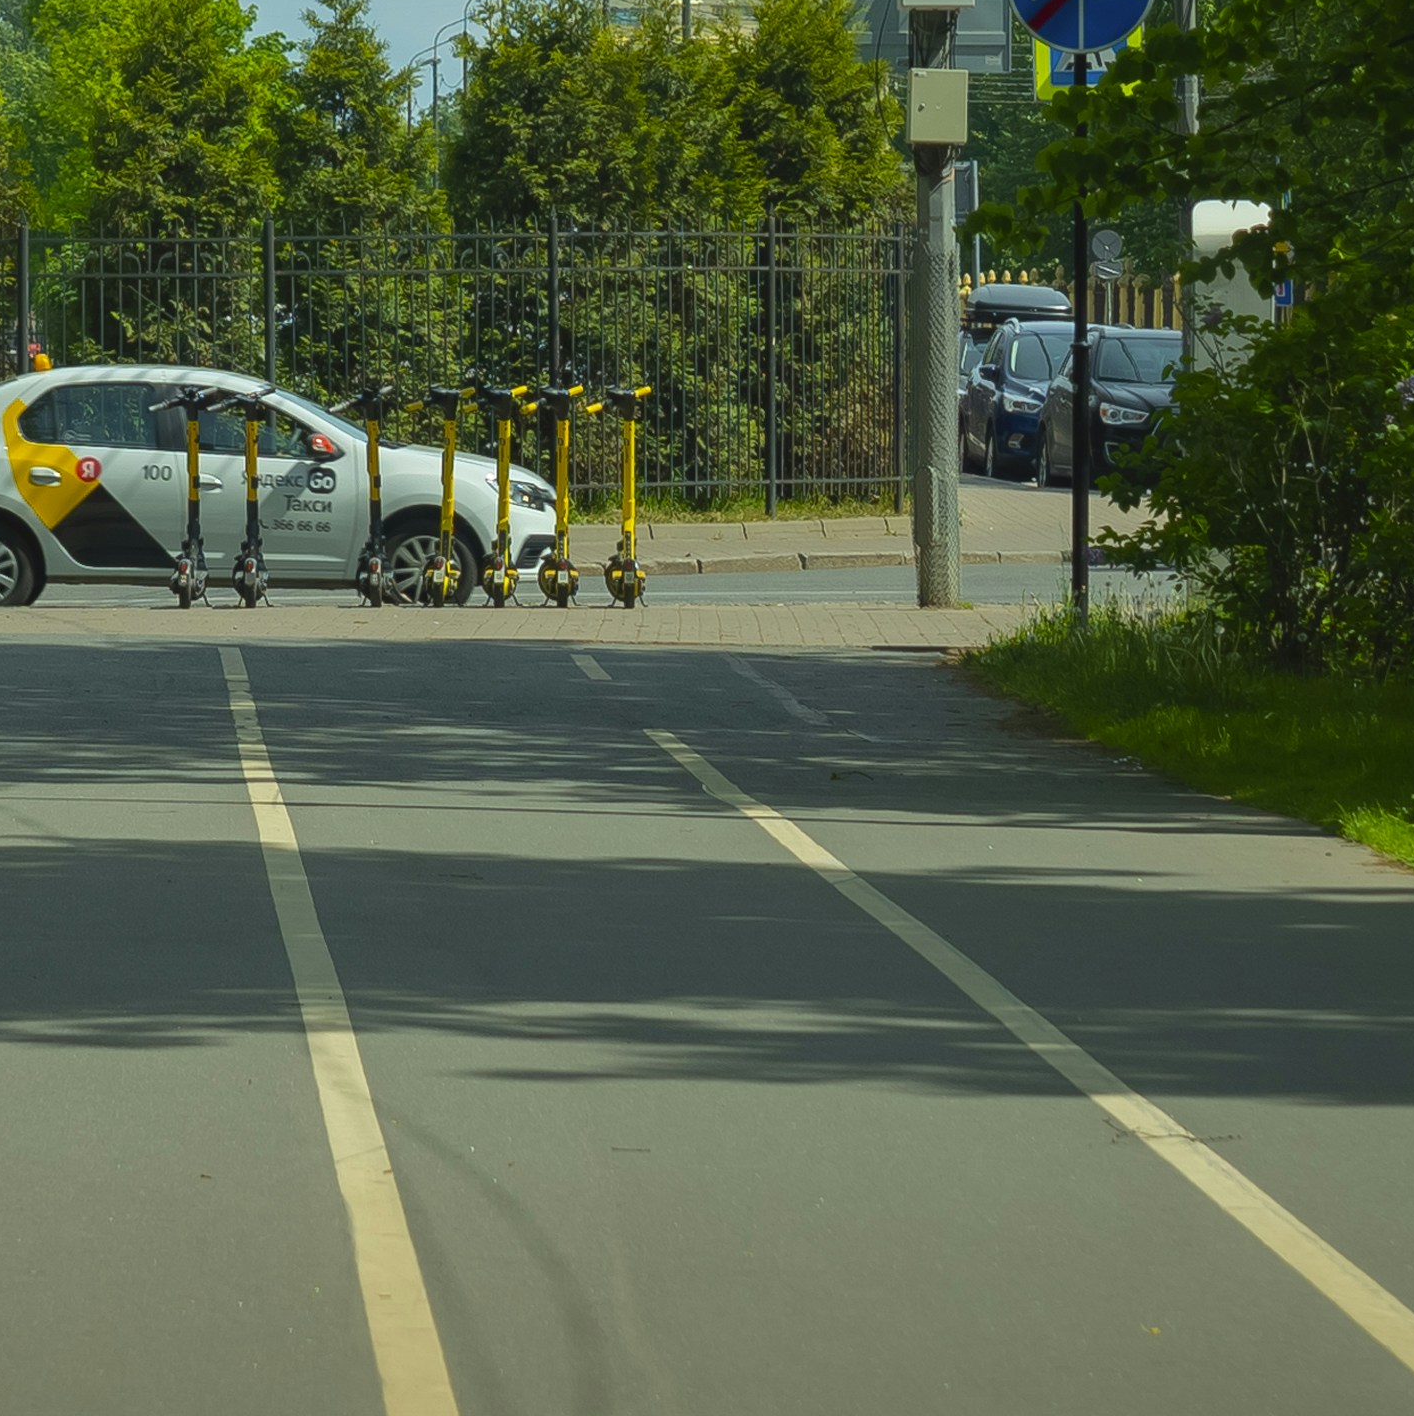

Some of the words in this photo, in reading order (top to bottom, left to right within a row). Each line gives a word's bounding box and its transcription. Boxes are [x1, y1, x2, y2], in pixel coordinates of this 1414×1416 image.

[81, 461, 95, 478] Я
[142, 464, 172, 481] 100
[283, 494, 333, 513] Такси
